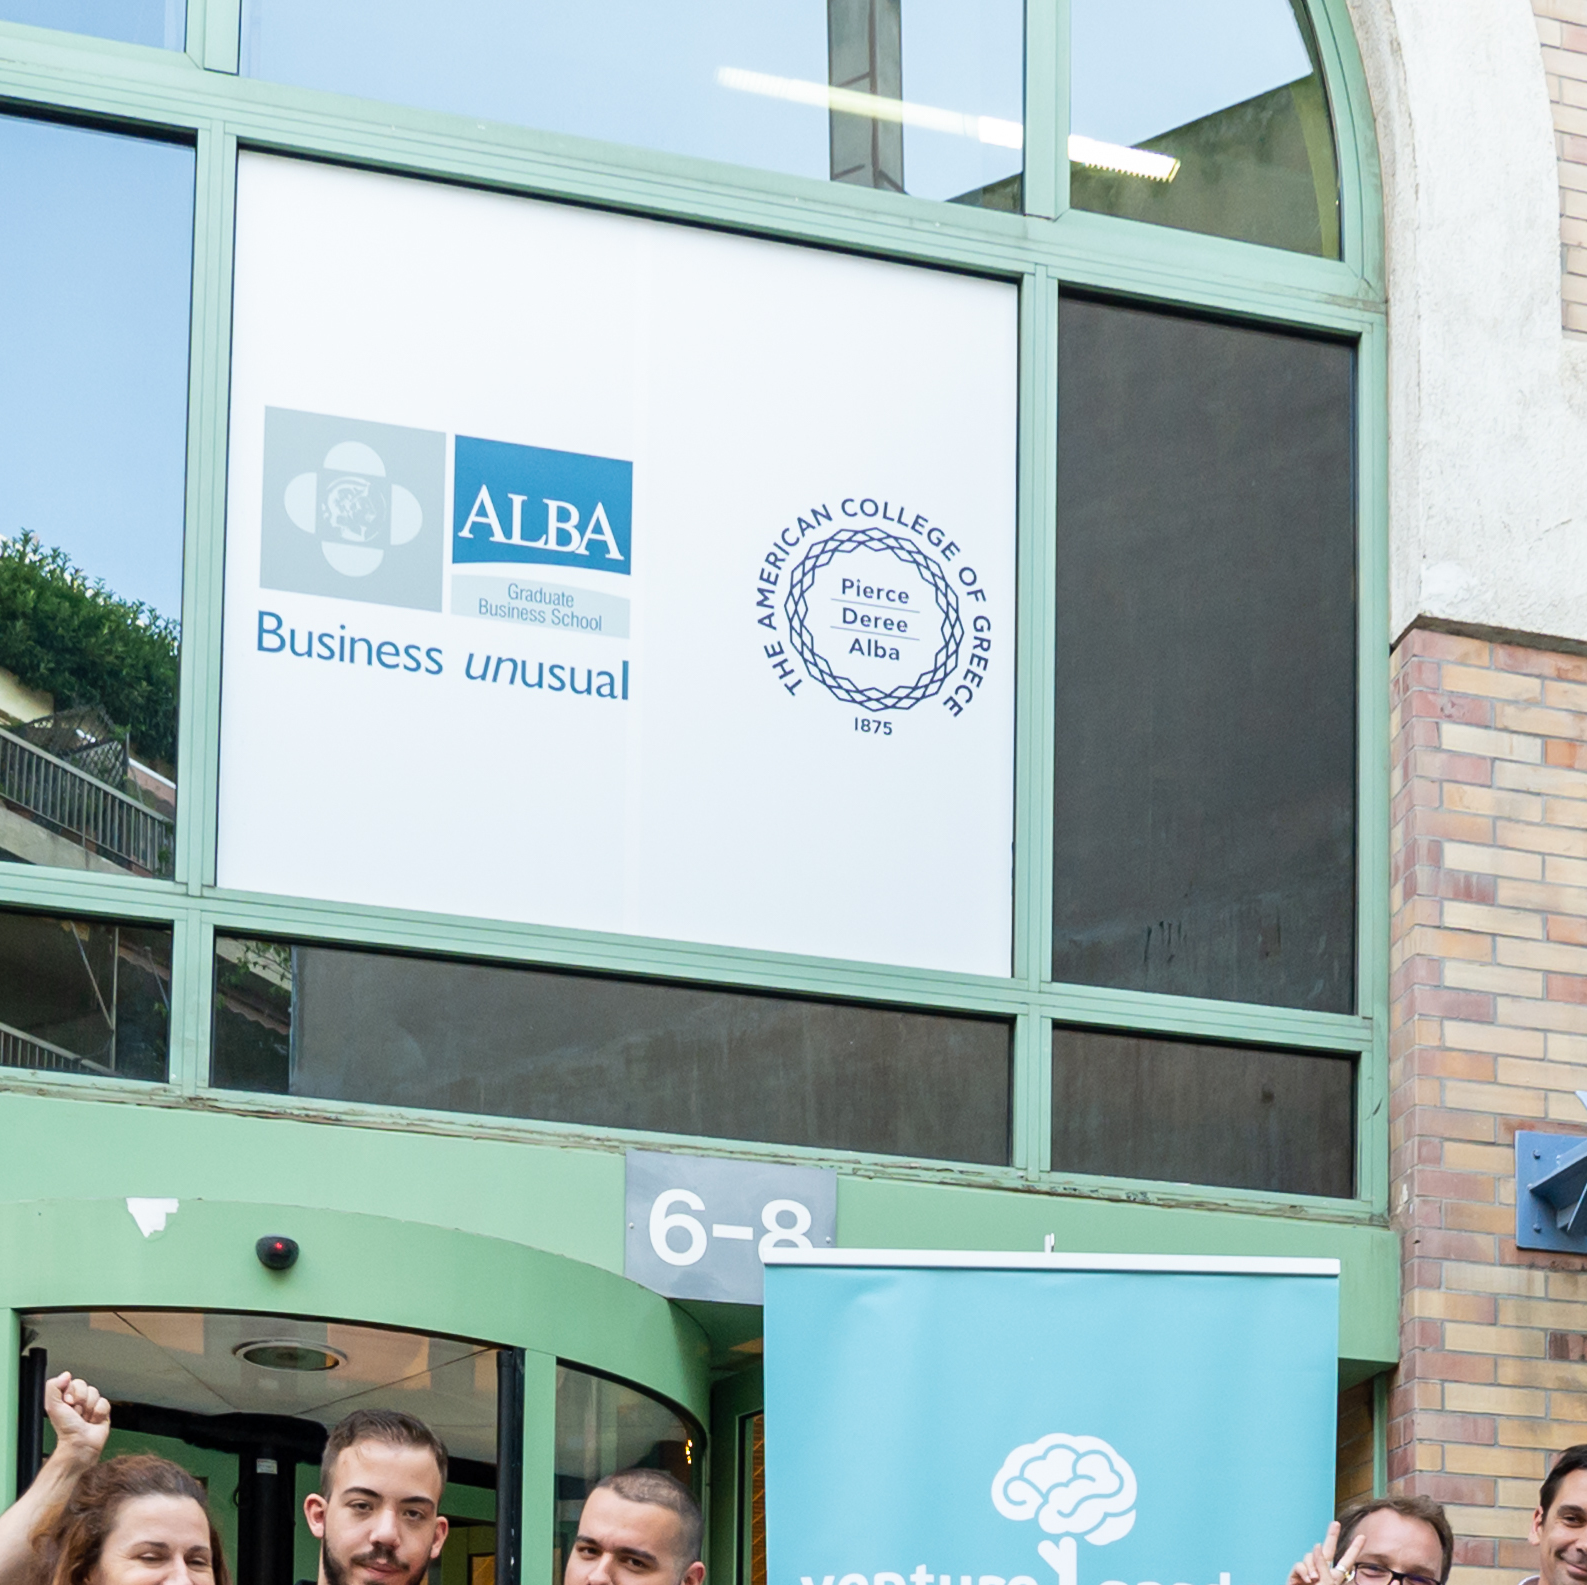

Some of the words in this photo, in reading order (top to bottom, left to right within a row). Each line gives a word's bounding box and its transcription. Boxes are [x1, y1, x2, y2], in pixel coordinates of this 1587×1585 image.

[458, 484, 625, 561] ALBA
[841, 498, 961, 562] COLLEGE
[756, 503, 833, 631] AMERICAN
[958, 566, 987, 603] OF
[508, 582, 574, 608] Graduate
[842, 577, 910, 605] Pierce
[478, 598, 546, 625] Business
[551, 603, 603, 632] School
[842, 607, 909, 633] Deree
[257, 610, 444, 675] Business
[464, 651, 630, 701] unusual
[849, 637, 901, 661] Alba
[942, 614, 992, 718] GREECE
[763, 640, 803, 697] THE
[855, 716, 894, 736] 1875
